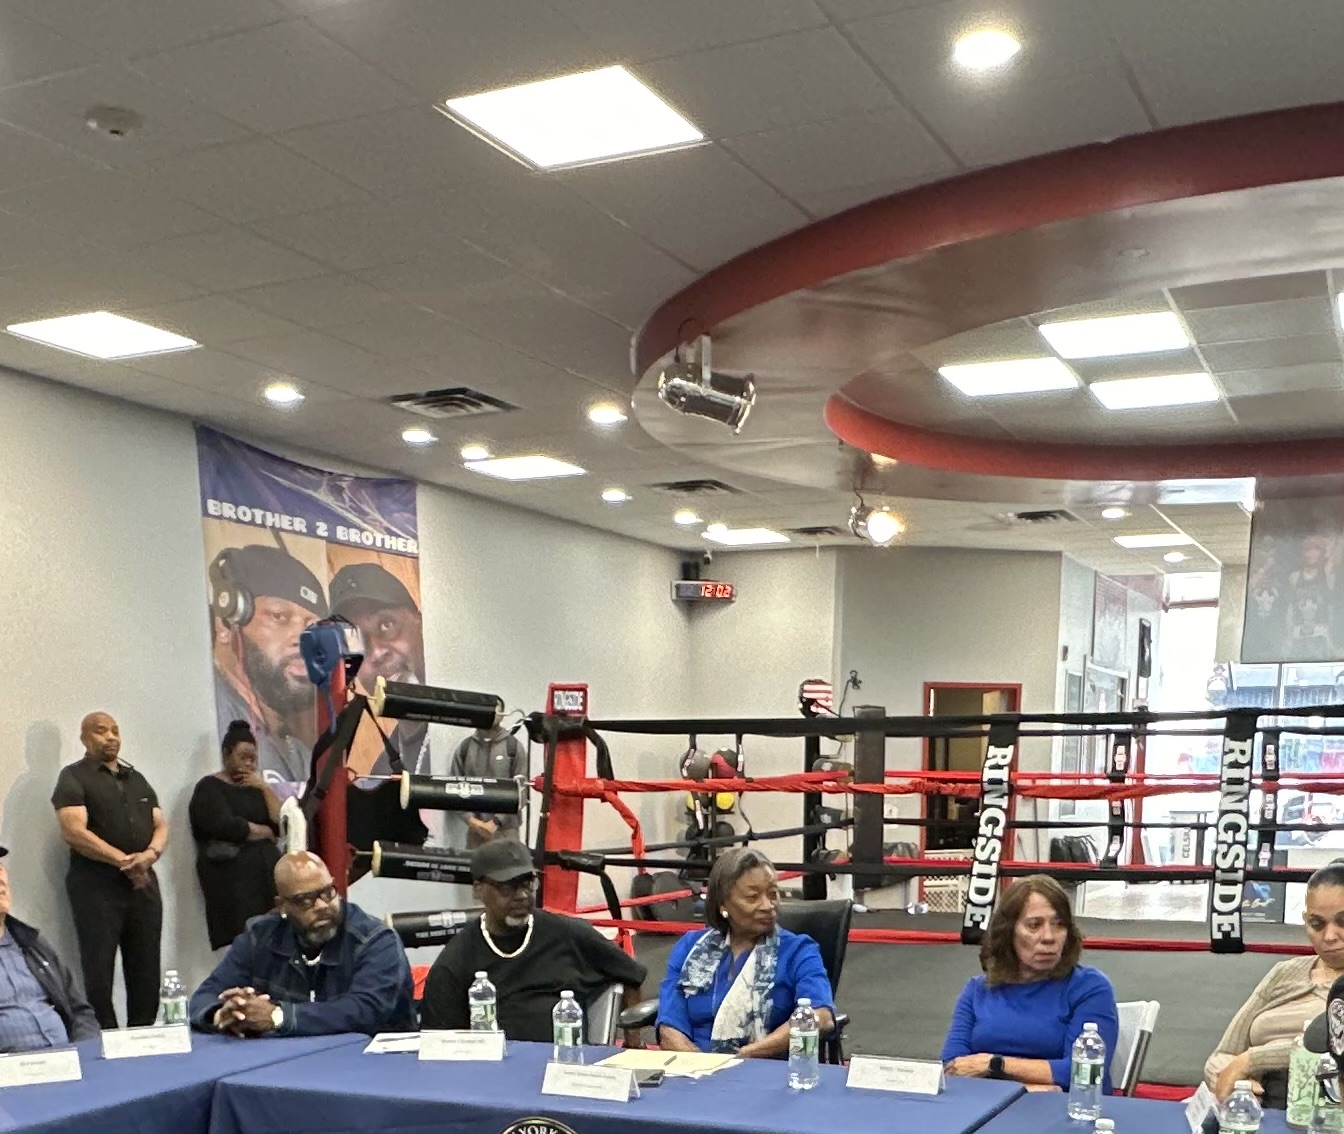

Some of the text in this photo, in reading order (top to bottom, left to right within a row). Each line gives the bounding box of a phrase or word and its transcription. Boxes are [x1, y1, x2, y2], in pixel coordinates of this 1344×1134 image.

[206, 499, 420, 554] BROTHER 2 BROTHER
[963, 744, 1015, 931] RINGSIDE
[1211, 737, 1254, 940] RINGSIDE
